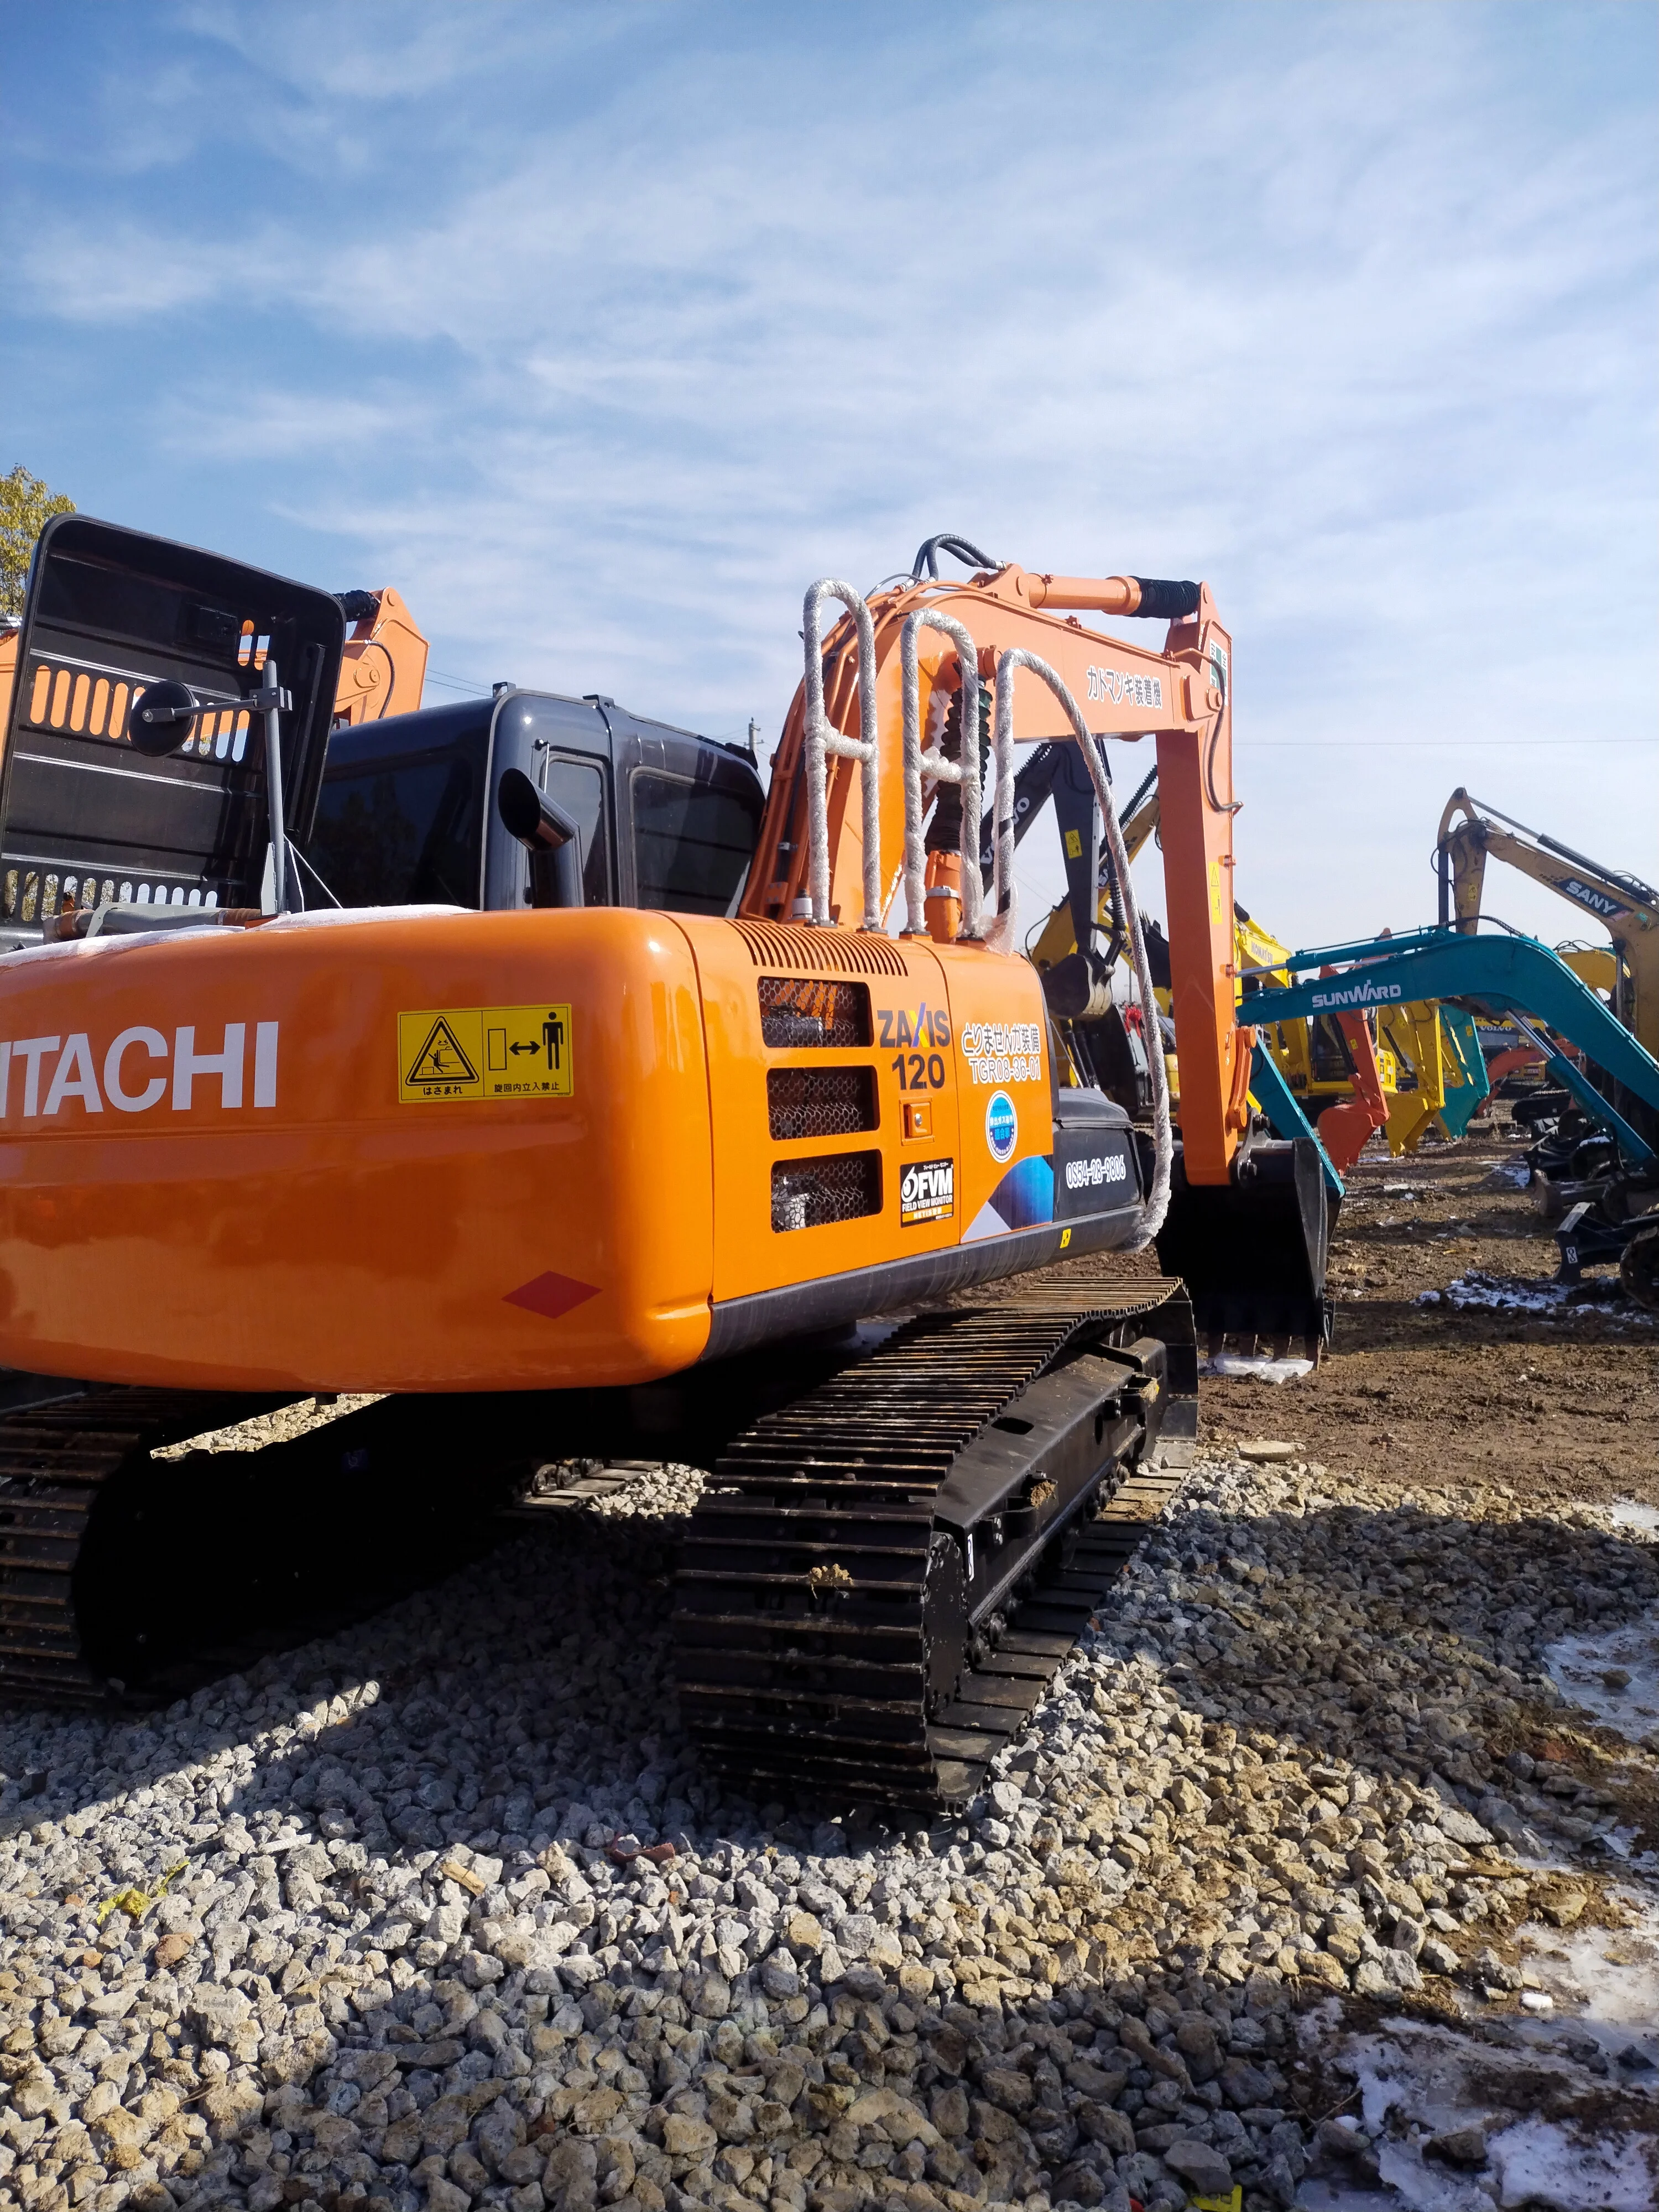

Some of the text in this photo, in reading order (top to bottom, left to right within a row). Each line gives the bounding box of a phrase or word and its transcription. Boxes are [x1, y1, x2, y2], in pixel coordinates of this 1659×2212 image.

[1566, 880, 1617, 914] SANY
[1251, 941, 1273, 965] KOMATSU
[1312, 979, 1401, 1008] SUNWARD
[877, 1002, 951, 1048] ZAXIS
[892, 1054, 945, 1091] 120
[969, 1056, 1041, 1084] TGR08-36-01
[423, 1085, 463, 1095] はさまれ
[494, 1082, 560, 1093] 旋回内立入禁止
[902, 1194, 953, 1213] FIELD VIEW MONITOR
